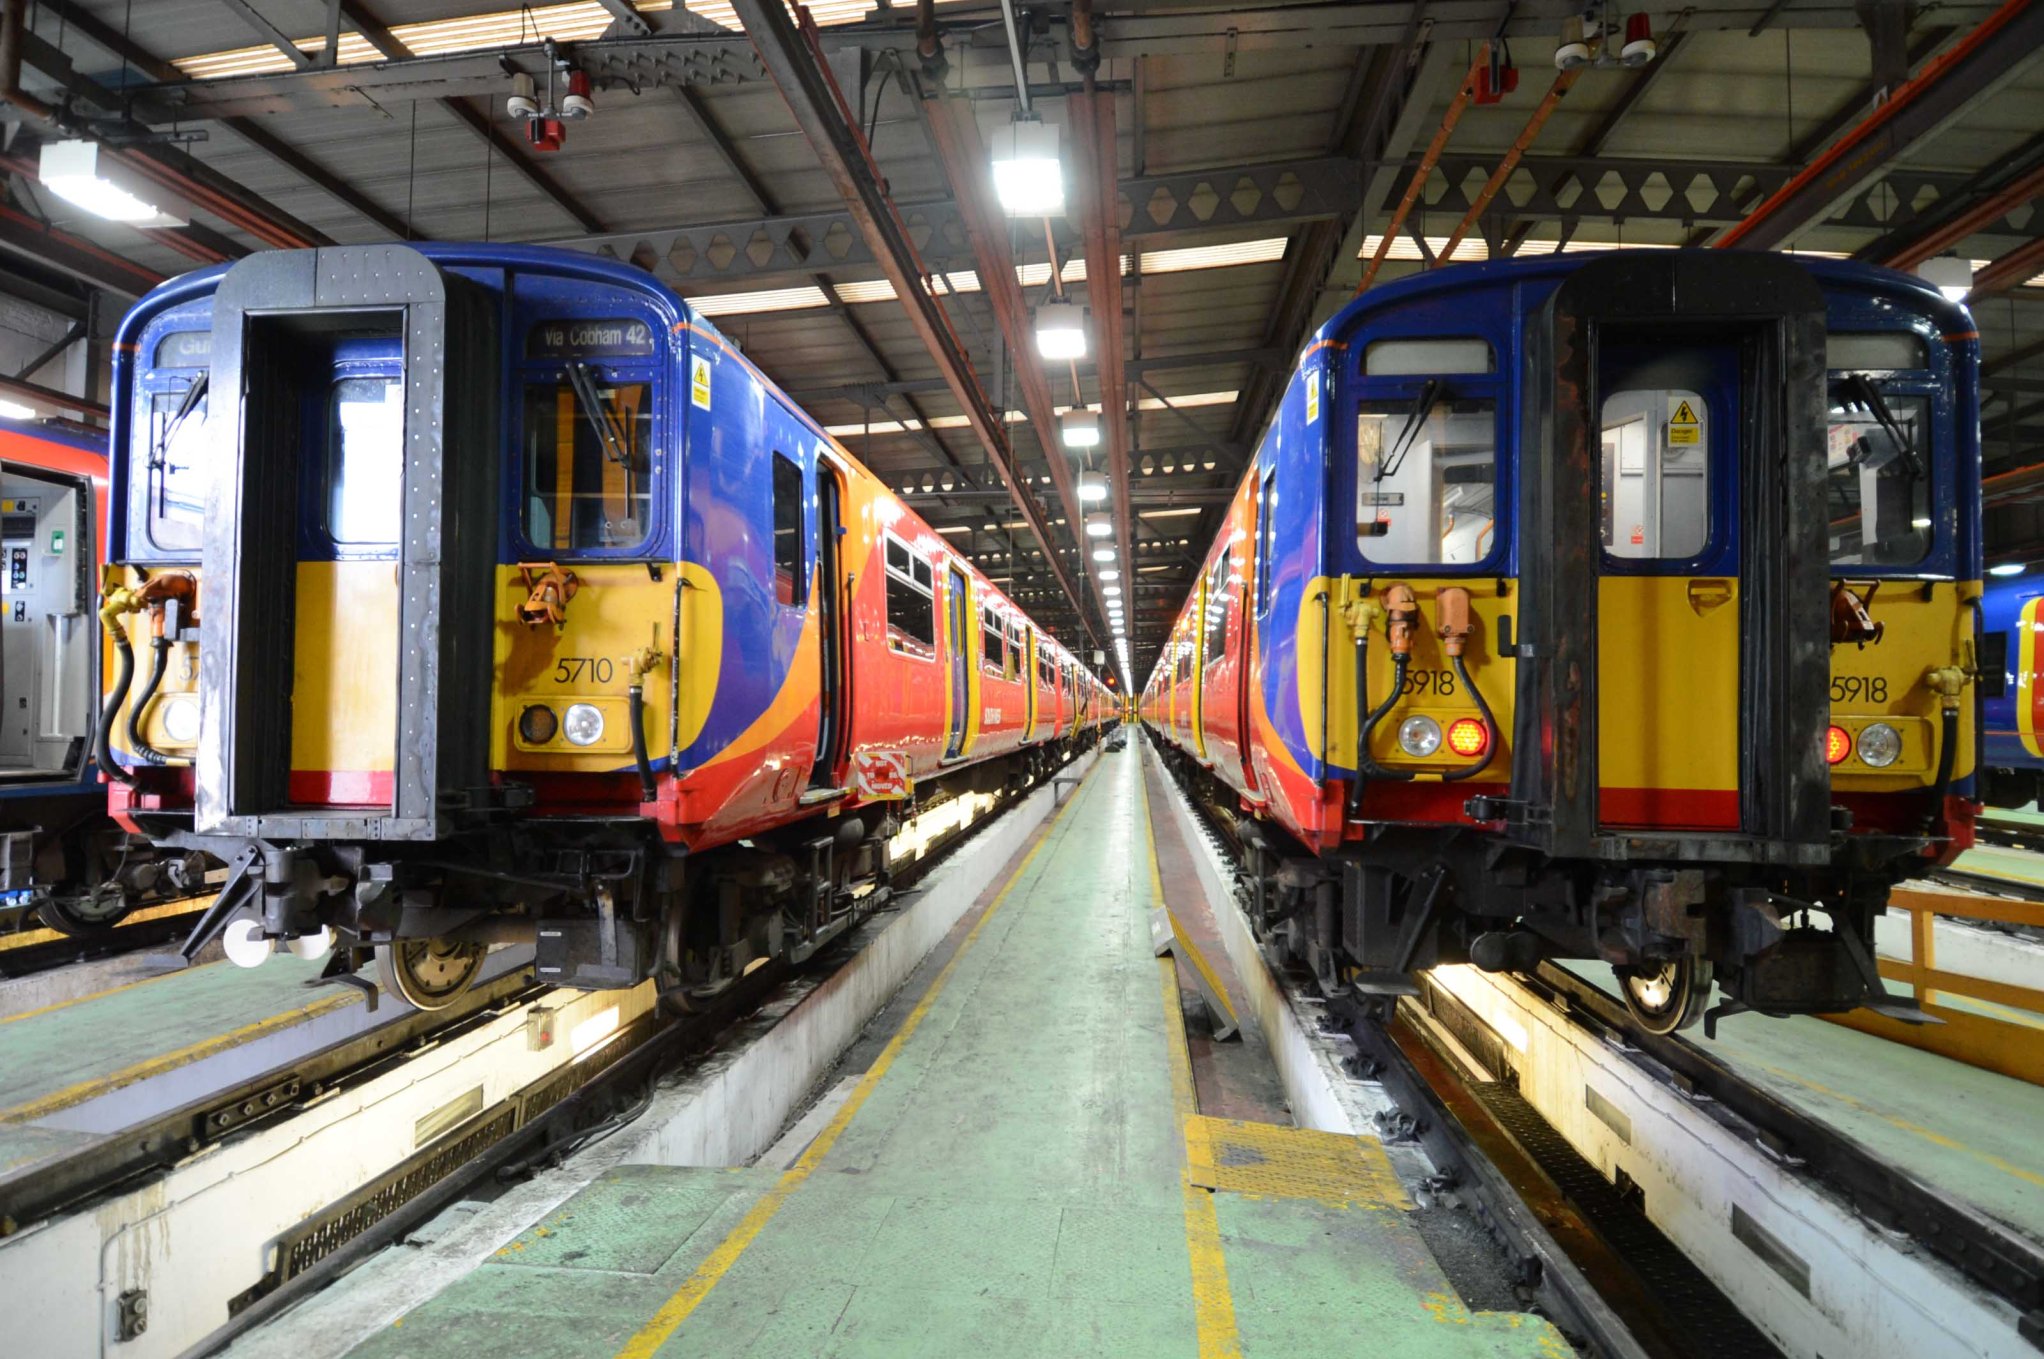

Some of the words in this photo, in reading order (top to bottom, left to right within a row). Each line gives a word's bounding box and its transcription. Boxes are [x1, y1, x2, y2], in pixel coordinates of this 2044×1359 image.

[569, 326, 621, 345] Cobham
[626, 325, 646, 344] 42
[554, 657, 613, 683] 5710
[1829, 676, 1888, 703] 5918
